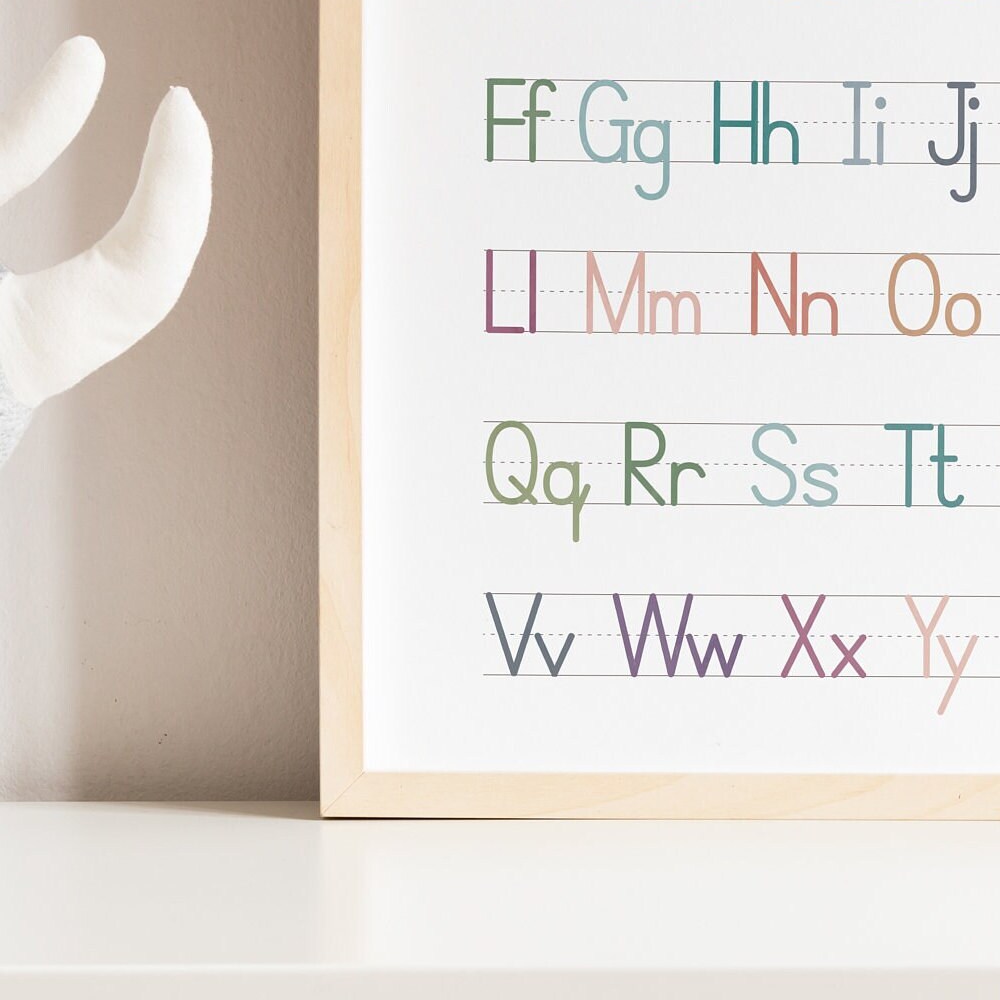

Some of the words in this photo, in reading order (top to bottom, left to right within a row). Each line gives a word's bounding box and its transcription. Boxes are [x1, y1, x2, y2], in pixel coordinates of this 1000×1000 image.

[486, 78, 556, 163] Ff
[579, 79, 670, 200] Gg
[713, 80, 799, 165] Hh
[842, 81, 886, 165] Ii
[928, 82, 980, 203] Jj
[486, 249, 537, 334] Ll
[586, 251, 701, 335] Mm
[751, 252, 838, 336] Nn
[888, 252, 981, 337] Oo
[485, 420, 591, 542] Qq
[624, 422, 706, 506] Rr
[751, 423, 838, 507] Ss
[884, 423, 964, 508] Tt
[486, 592, 575, 677] Vv
[612, 593, 743, 678] Ww
[781, 594, 866, 678] Xx
[905, 595, 977, 715] Yy
